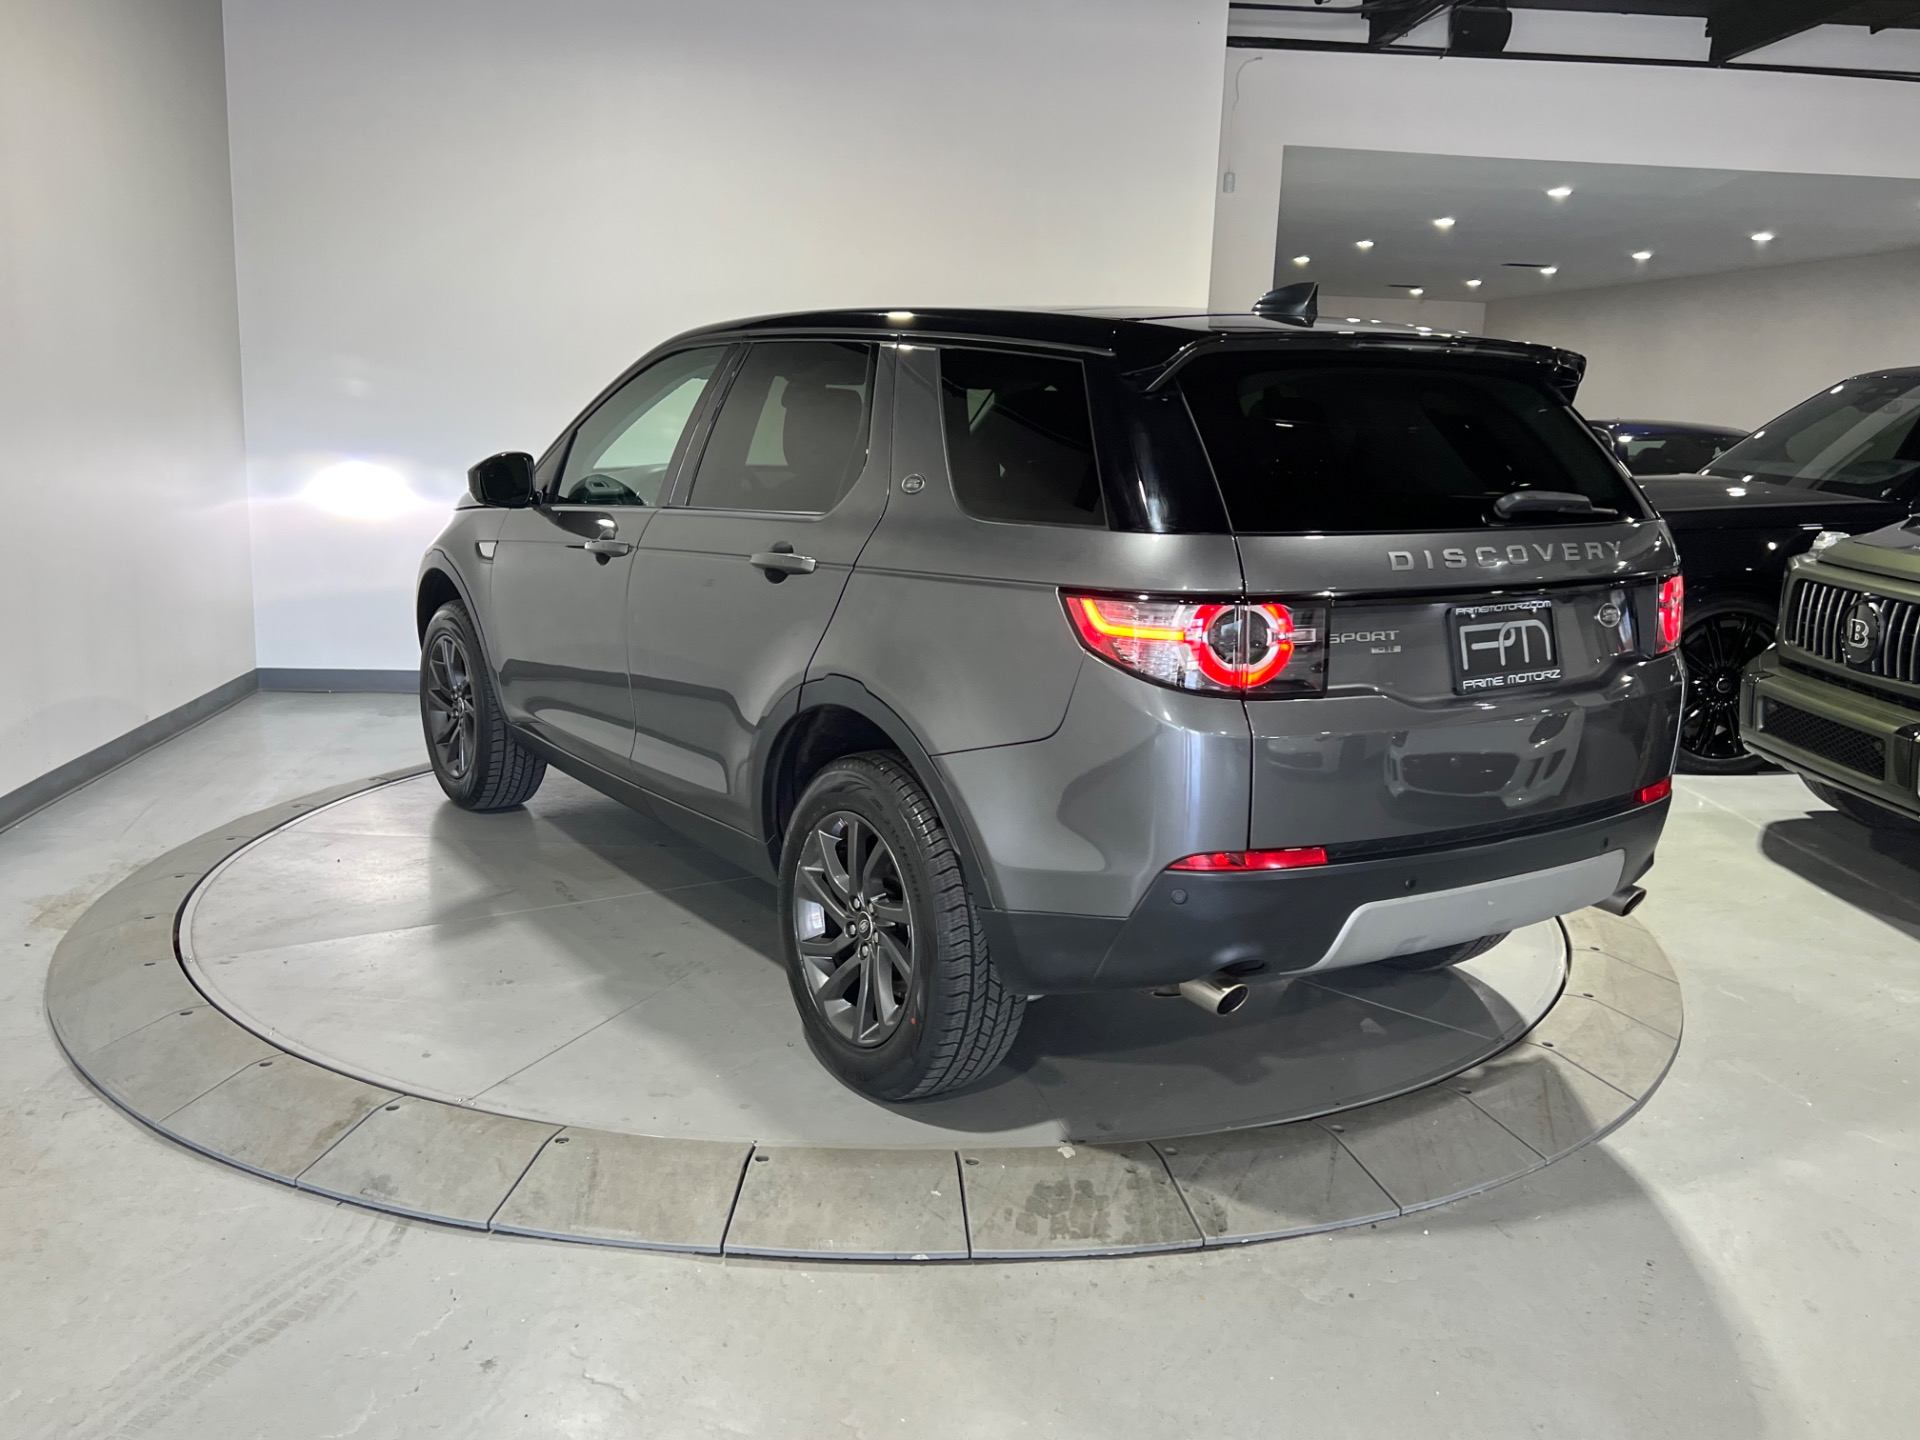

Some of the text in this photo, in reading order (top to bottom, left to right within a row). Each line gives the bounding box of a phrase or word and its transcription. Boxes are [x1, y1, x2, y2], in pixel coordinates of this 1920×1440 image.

[1387, 540, 1621, 571] DISCOVERY
[1329, 630, 1400, 644] SPORT
[1848, 618, 1870, 649] B
[1462, 669, 1561, 690] PRIME MOTORZ
